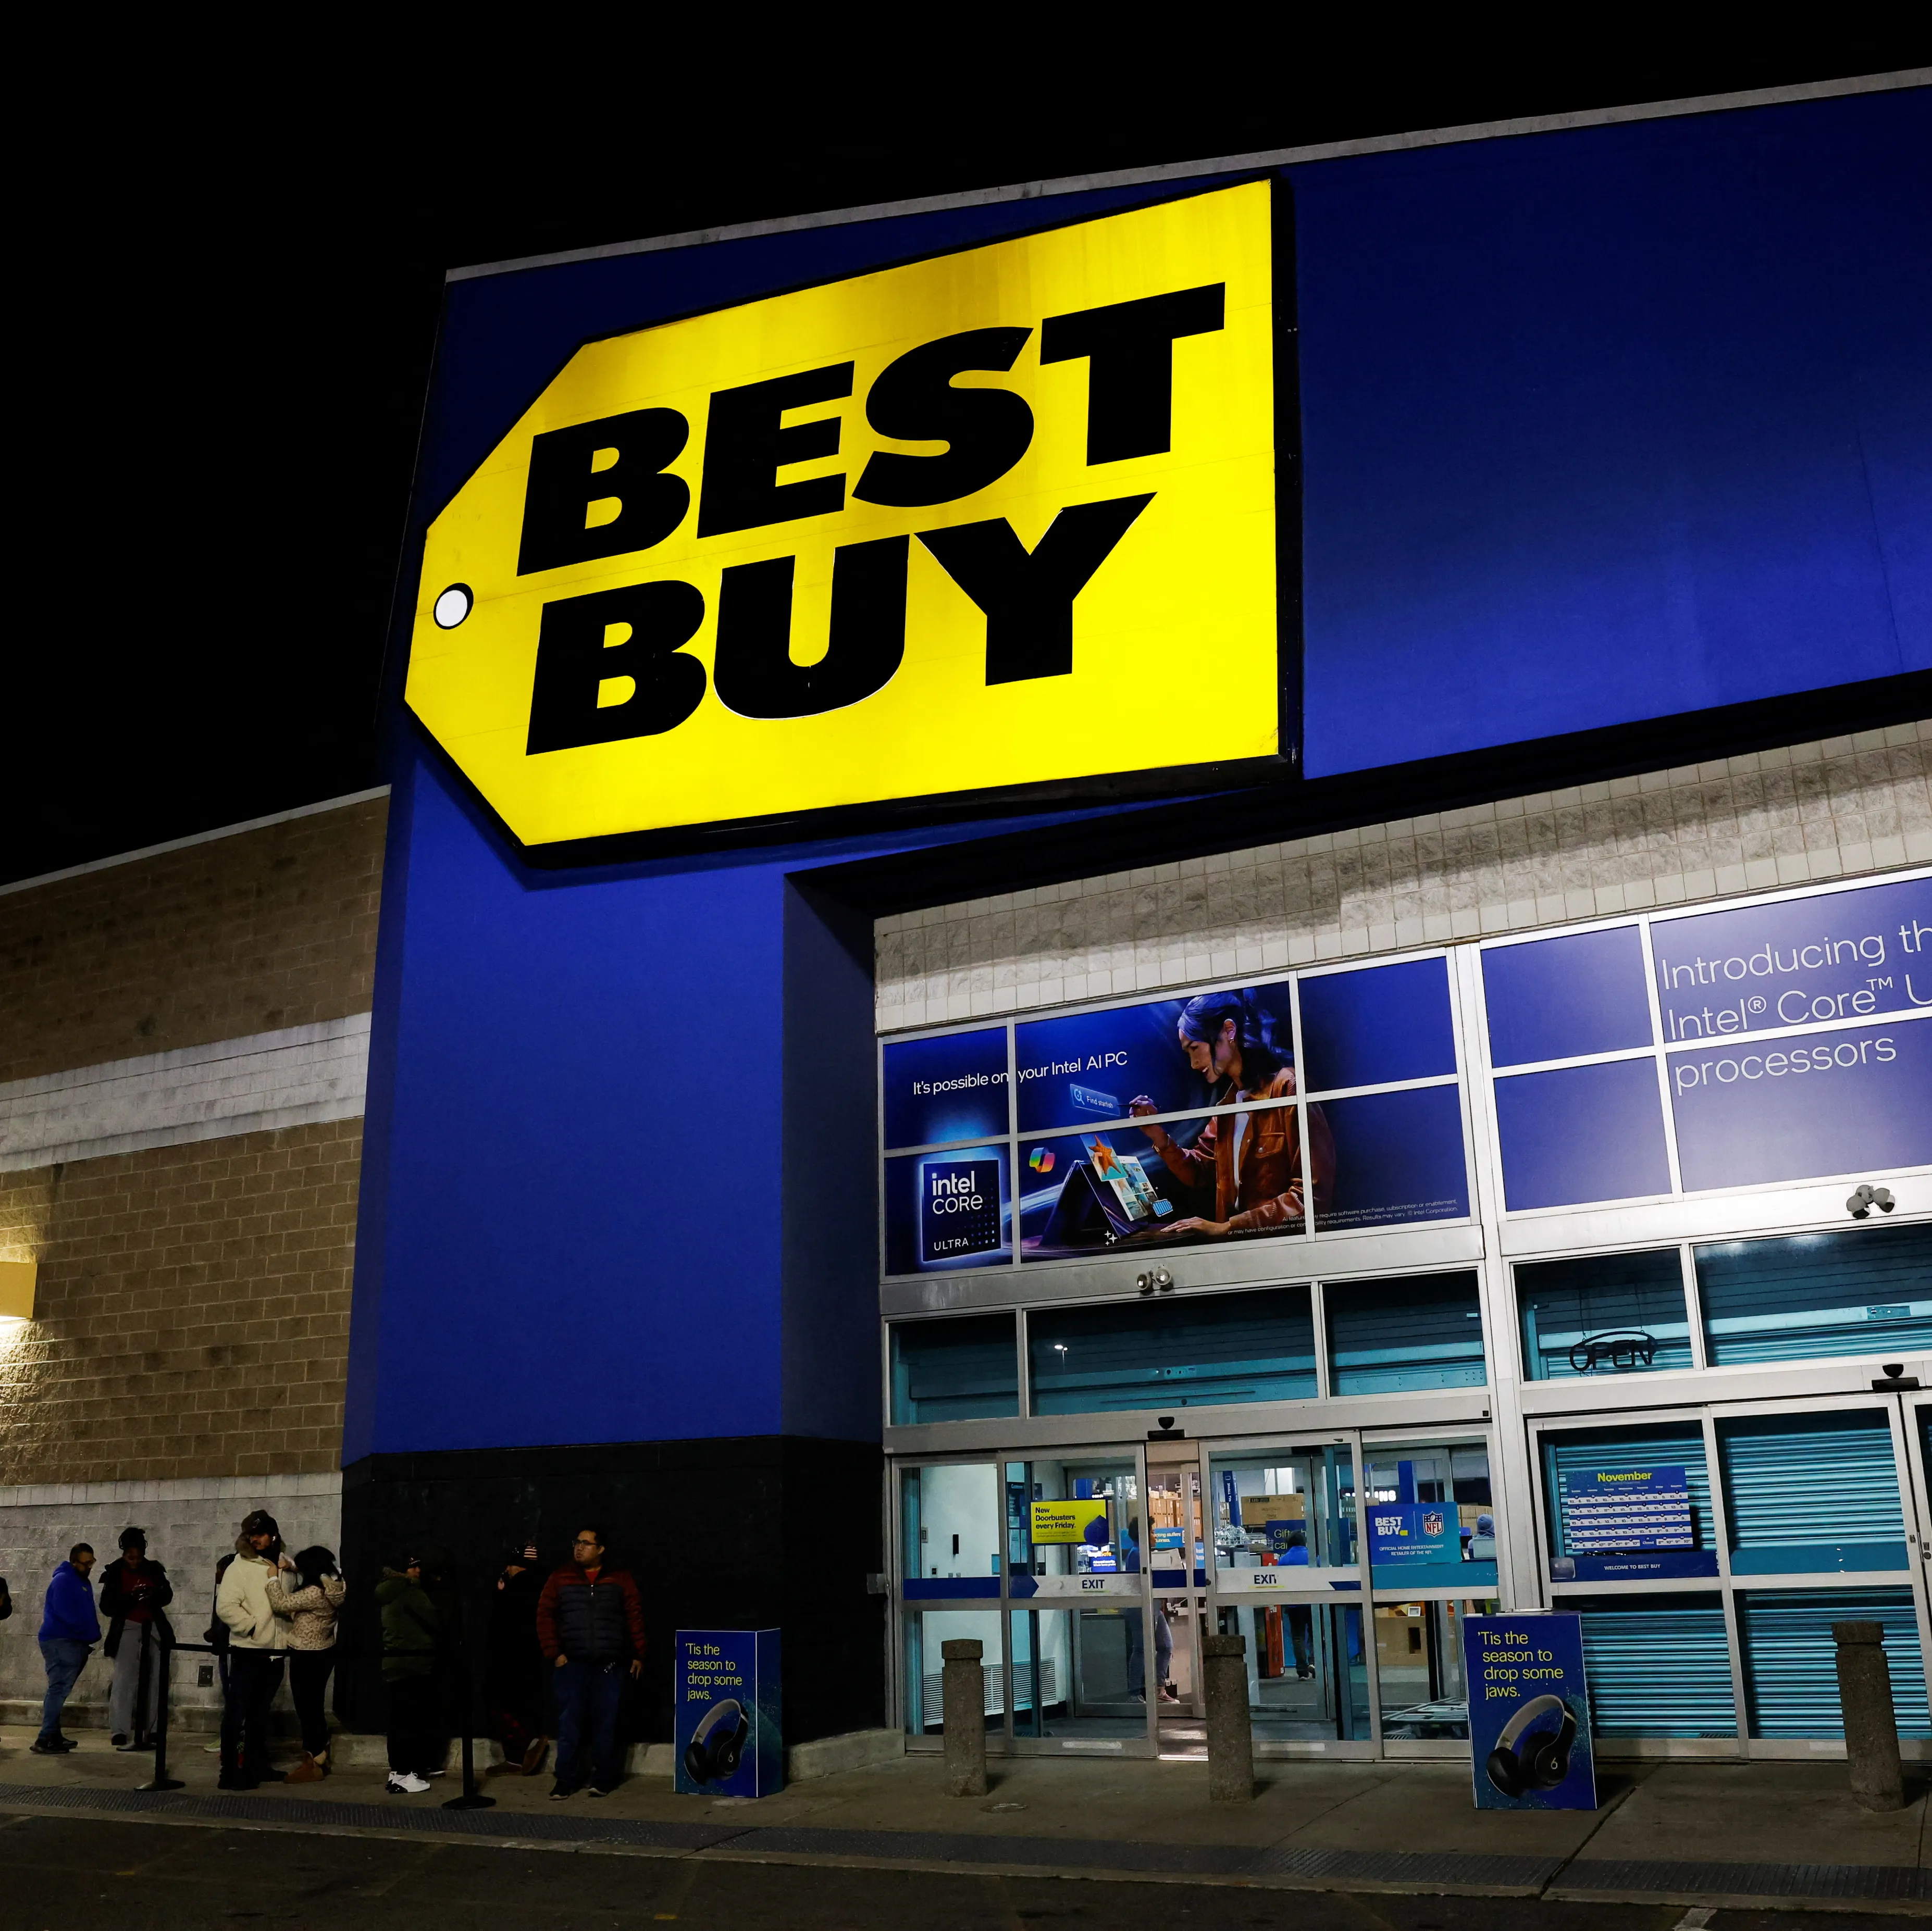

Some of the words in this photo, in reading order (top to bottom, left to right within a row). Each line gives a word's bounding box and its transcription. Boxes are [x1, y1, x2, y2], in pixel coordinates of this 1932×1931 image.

[517, 282, 1226, 576] BEST
[526, 491, 1159, 757] BUY
[1662, 937, 1885, 990] Introducing
[914, 1081, 931, 1095] It's
[933, 1073, 988, 1095] possible
[992, 1073, 1009, 1083] on
[1018, 1066, 1049, 1083] your
[1052, 1058, 1081, 1075] Intel
[1086, 1055, 1101, 1070] AI
[1106, 1051, 1128, 1067] PC
[1675, 1037, 1896, 1095] processors
[1086, 1095, 1098, 1105] Find
[1098, 1100, 1113, 1108] starfish
[932, 1170, 975, 1195] intel
[934, 1238, 969, 1251] ULTRA
[1569, 1340, 1653, 1371] OPEN
[1597, 1471, 1652, 1482] November
[1375, 1517, 1403, 1527] BEST
[1426, 1521, 1442, 1534] NFL
[1378, 1526, 1401, 1536] BUY
[1082, 1579, 1105, 1589] EXIT
[1478, 1631, 1501, 1645] 'Tis
[1505, 1630, 1528, 1645] the
[685, 1643, 701, 1655] 'Tis
[703, 1643, 720, 1655] the
[1482, 1651, 1533, 1662] season
[1538, 1649, 1553, 1661] to
[688, 1661, 722, 1671] season
[725, 1660, 736, 1671] to
[688, 1672, 711, 1687] drop
[714, 1676, 742, 1686] some
[1484, 1666, 1518, 1683] drop
[1522, 1668, 1564, 1679] some
[687, 1687, 712, 1702] jaws.
[1485, 1683, 1521, 1700] jaws.
